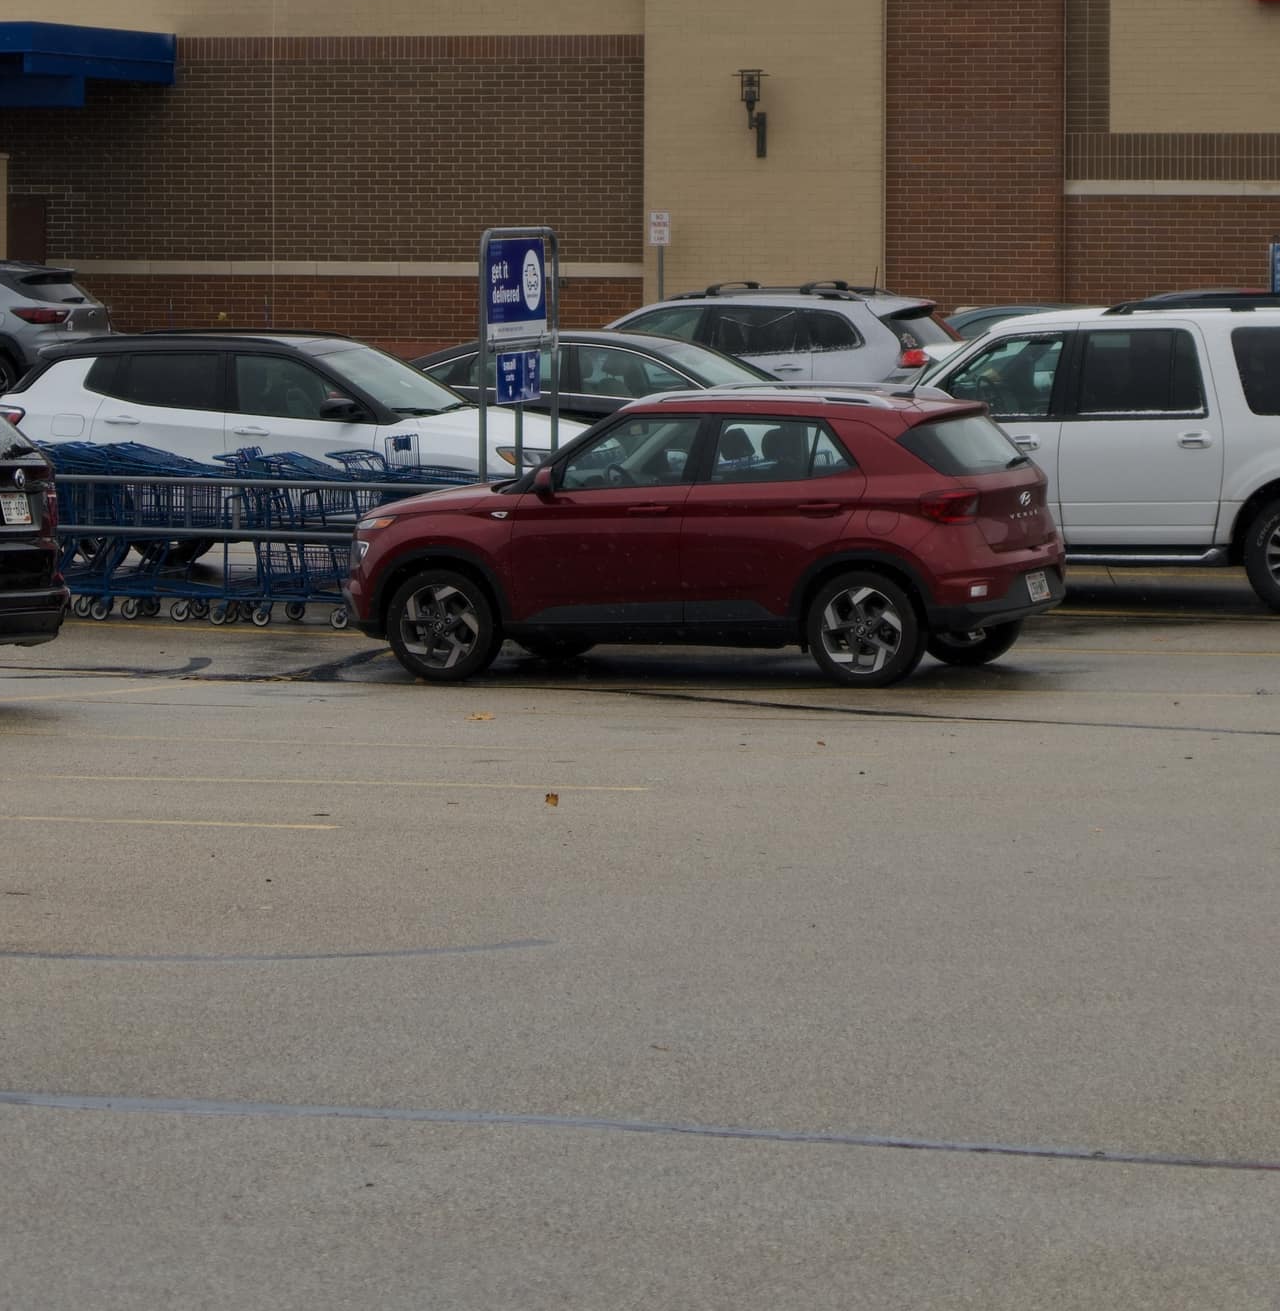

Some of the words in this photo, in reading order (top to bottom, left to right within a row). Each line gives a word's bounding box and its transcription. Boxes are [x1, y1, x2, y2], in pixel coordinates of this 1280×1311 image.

[491, 262, 502, 283] get
[503, 260, 509, 279] it
[492, 285, 520, 304] delivered
[503, 358, 516, 371] small
